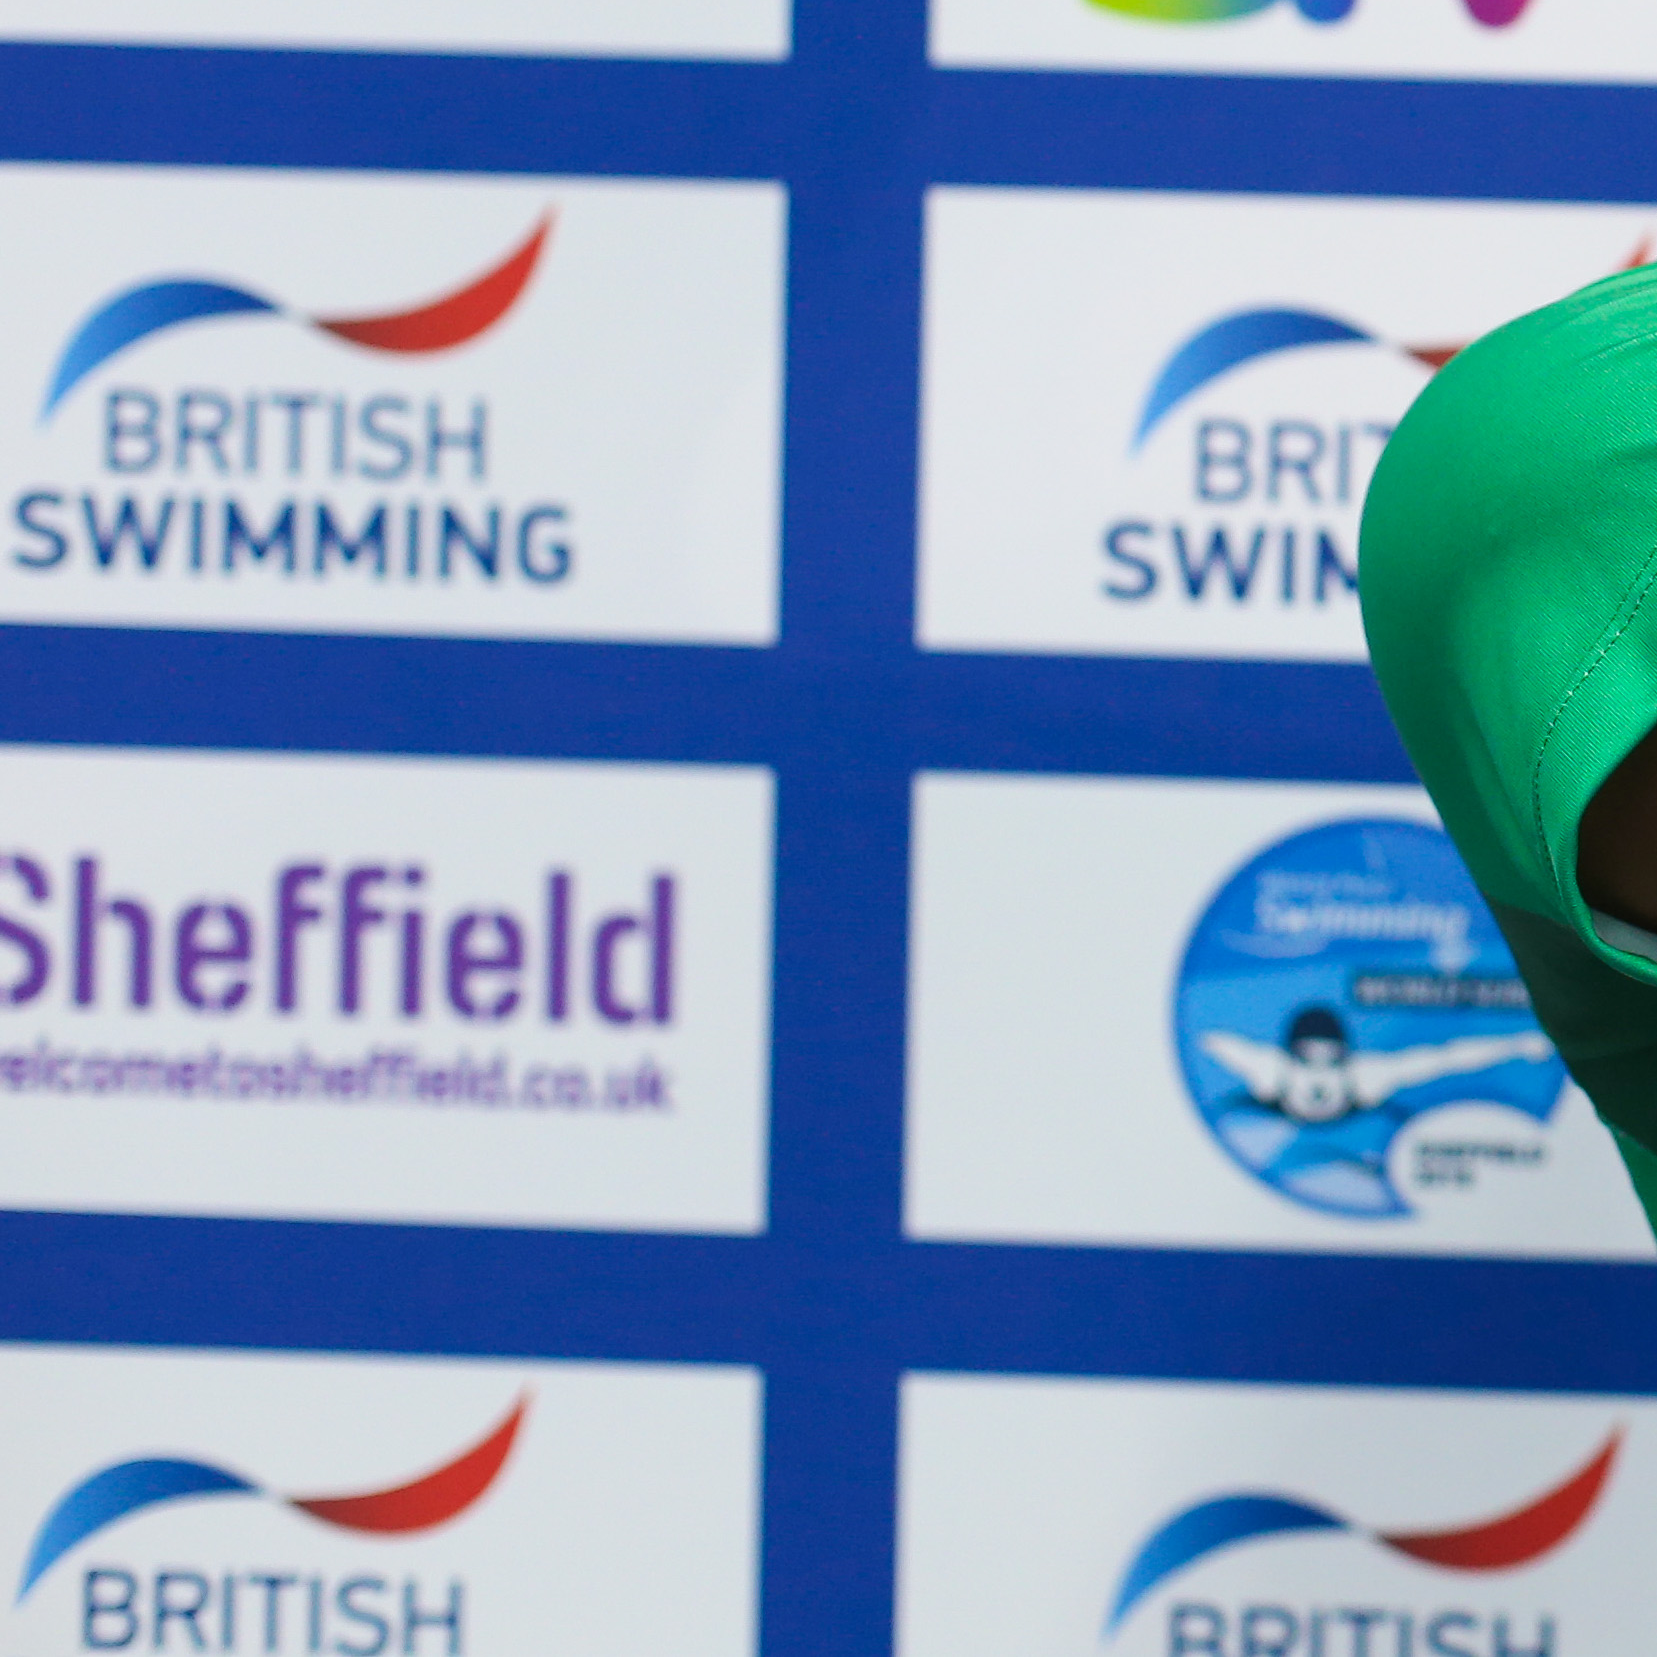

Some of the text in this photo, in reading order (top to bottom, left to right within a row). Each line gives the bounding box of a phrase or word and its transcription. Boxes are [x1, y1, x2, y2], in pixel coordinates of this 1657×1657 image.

[103, 388, 487, 483] BRITISH
[14, 491, 571, 585] SWIMMING
[0, 1039, 671, 1109] elcometosheffield.co.uk
[81, 1567, 463, 1657] BRITISH
